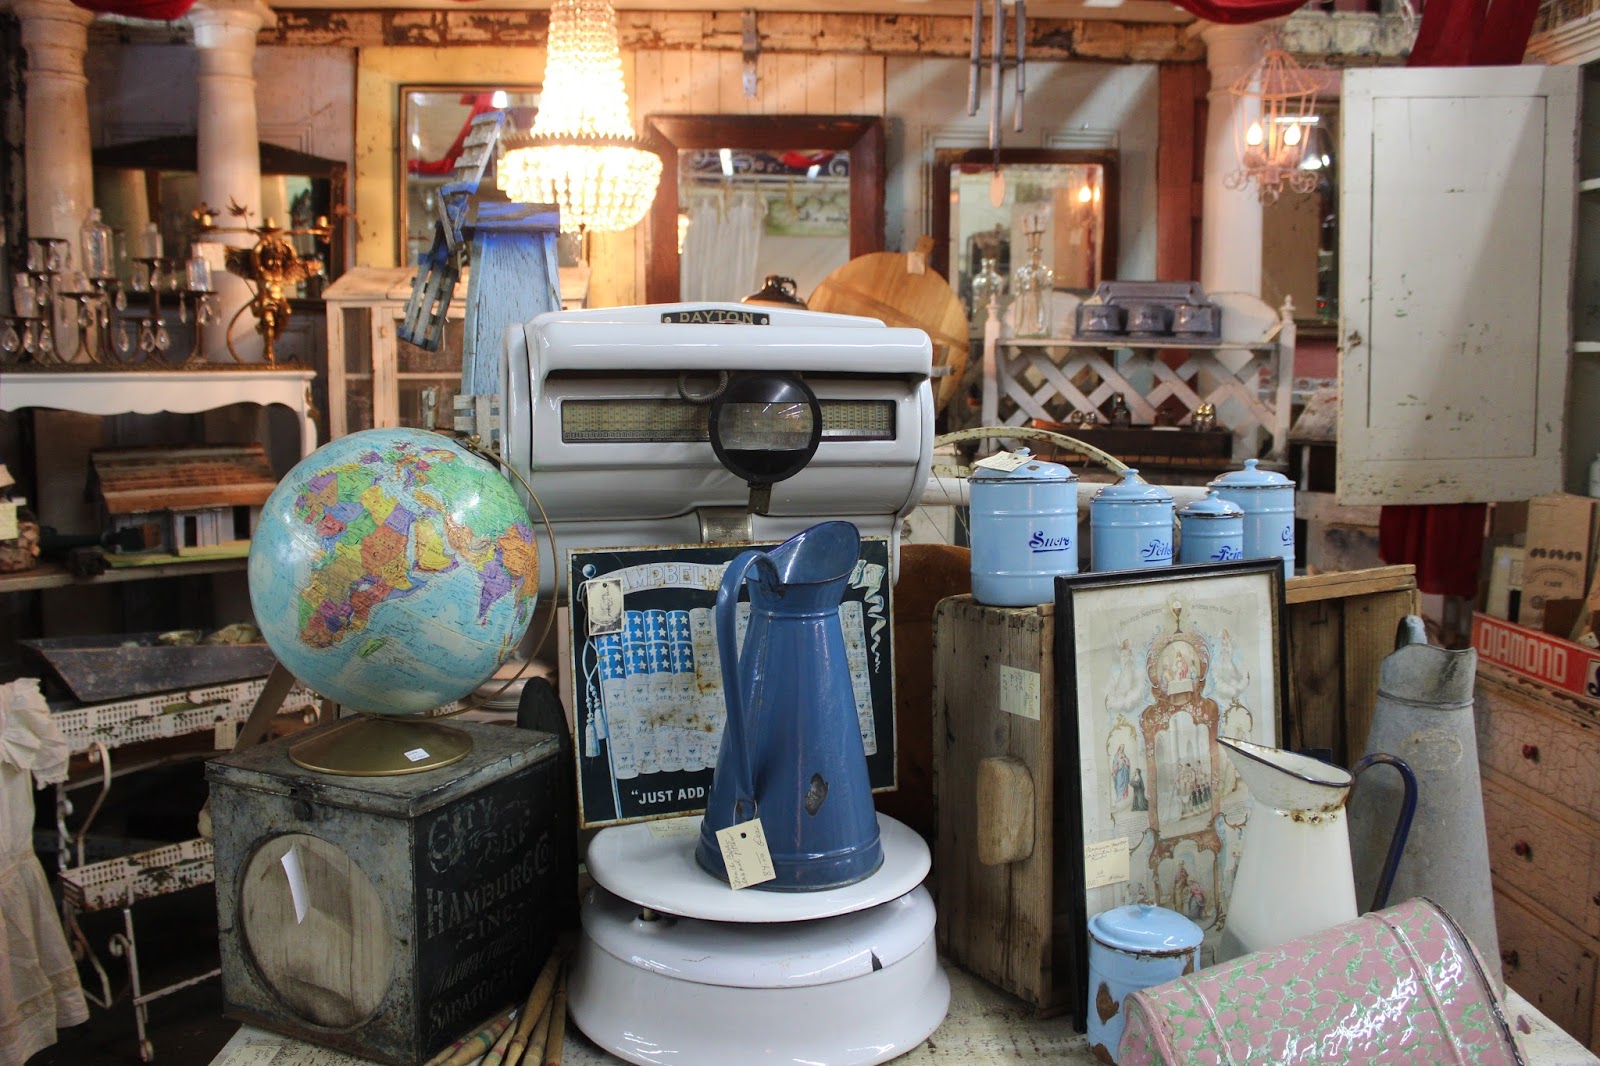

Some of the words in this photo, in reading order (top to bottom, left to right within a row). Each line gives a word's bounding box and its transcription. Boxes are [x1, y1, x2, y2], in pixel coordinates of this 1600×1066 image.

[679, 310, 754, 323] DAYTON
[1479, 622, 1568, 684] DIAMOND
[677, 786, 705, 801] ADD
